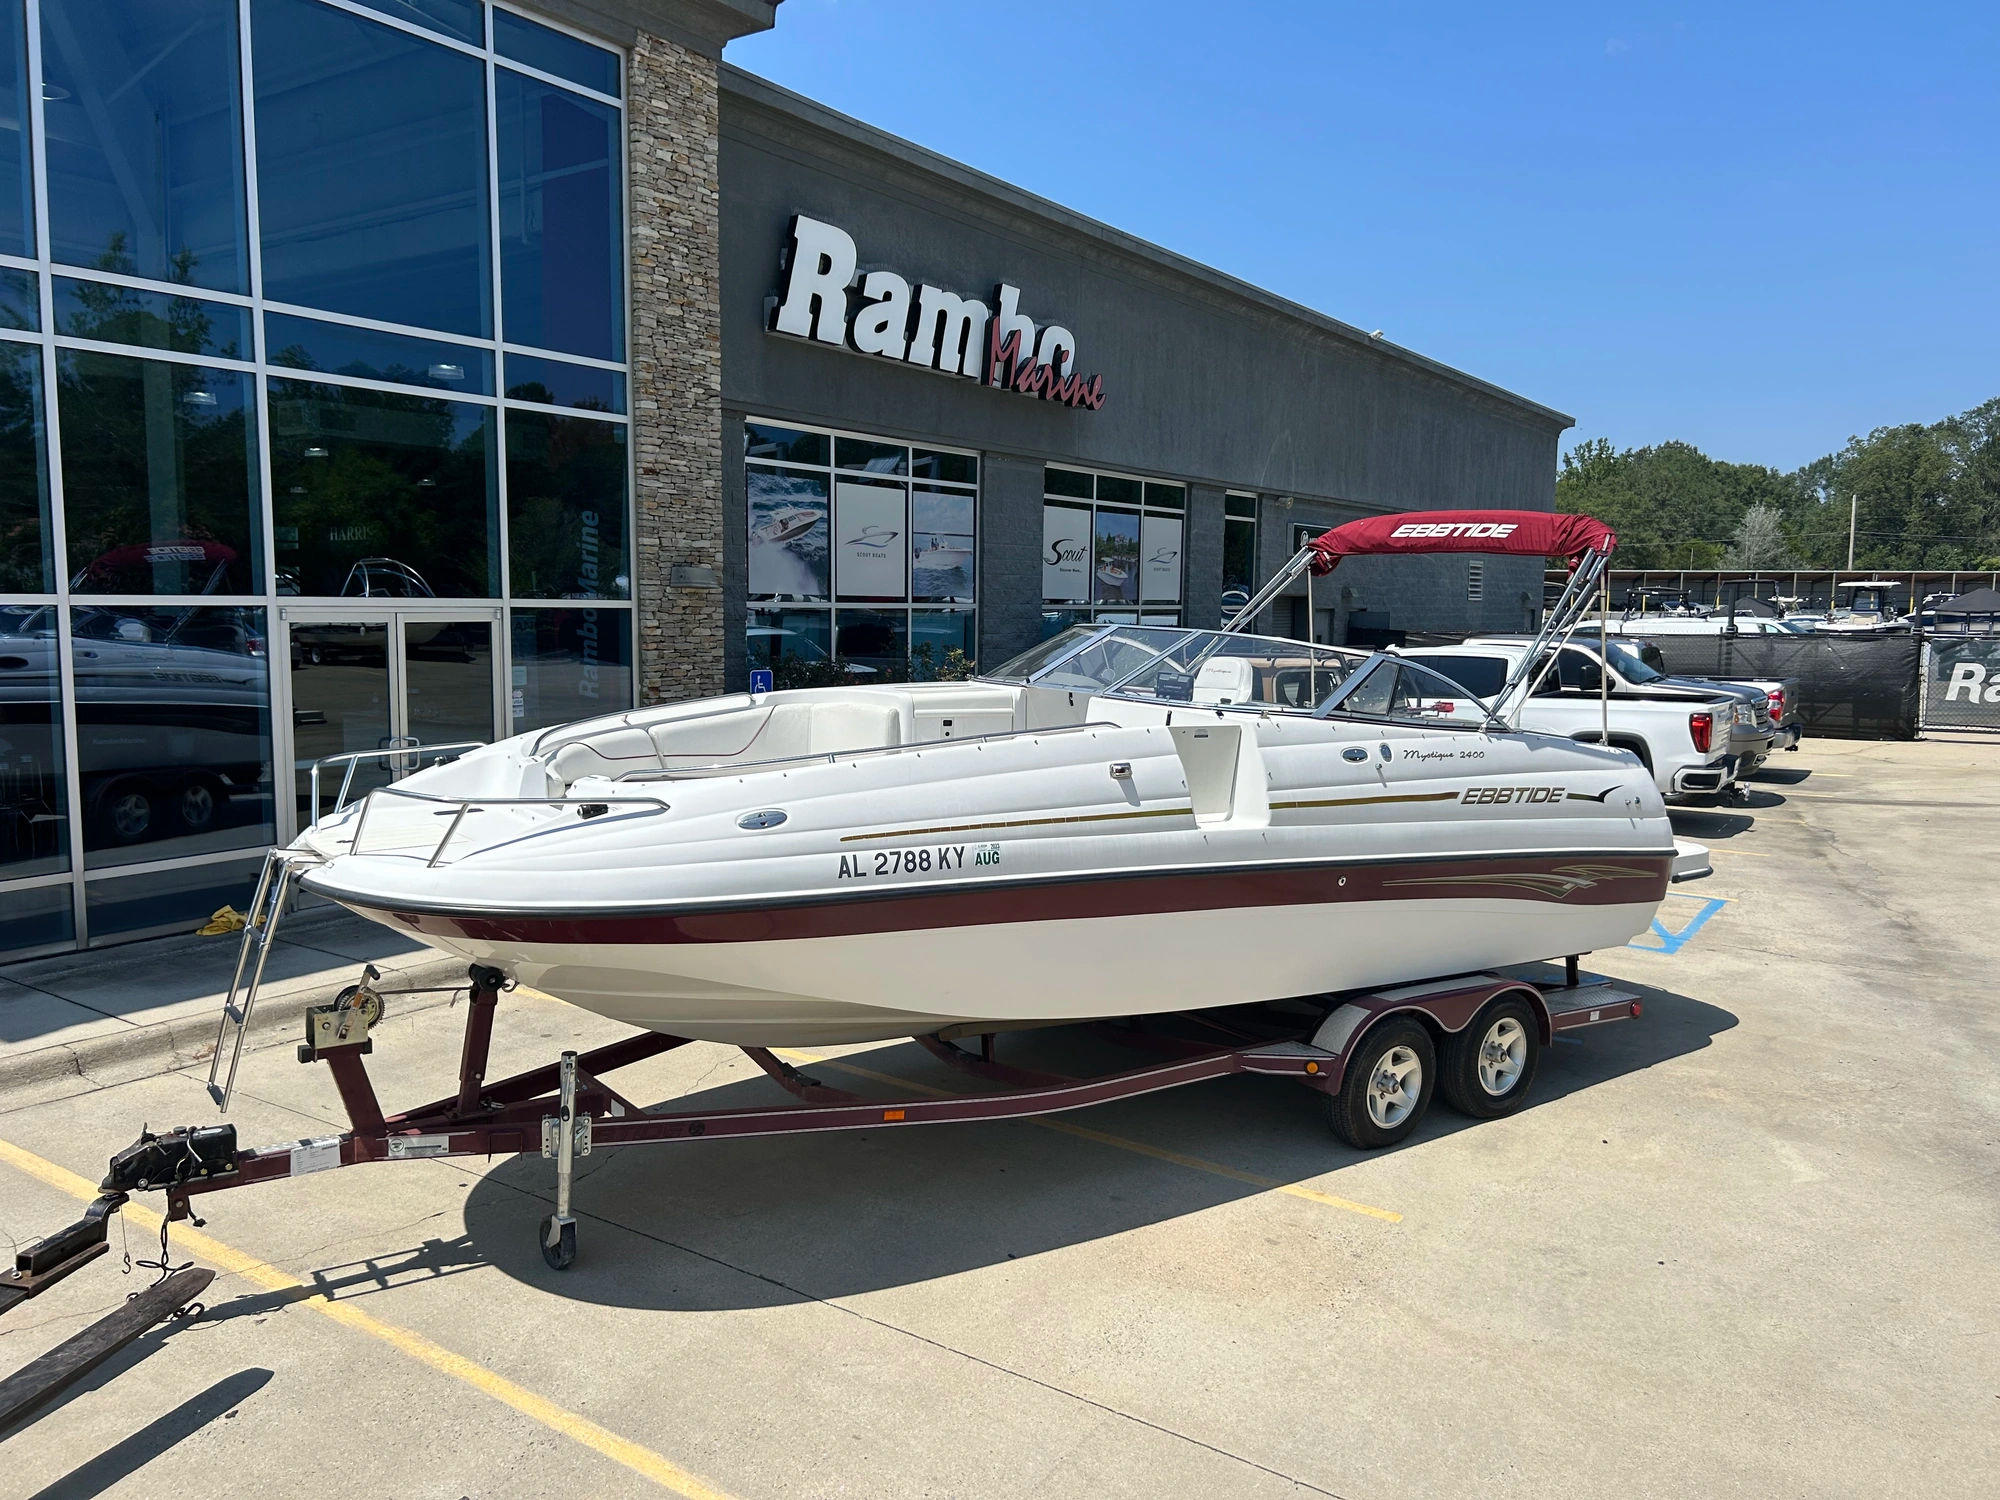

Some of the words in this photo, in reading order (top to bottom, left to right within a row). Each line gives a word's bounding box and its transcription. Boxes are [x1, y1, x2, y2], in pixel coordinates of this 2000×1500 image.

[769, 213, 1077, 389] Rambo
[984, 316, 1106, 411] Marine
[1390, 523, 1519, 539] EBBTIDE
[1043, 538, 1088, 566] Scout
[1403, 749, 1455, 762] Mystique
[1459, 750, 1486, 760] 2400
[1460, 786, 1566, 805] EBBTIDE
[837, 854, 867, 879] AL
[874, 849, 932, 876] 2788
[937, 845, 966, 870] KY
[974, 850, 1000, 866] AUG
